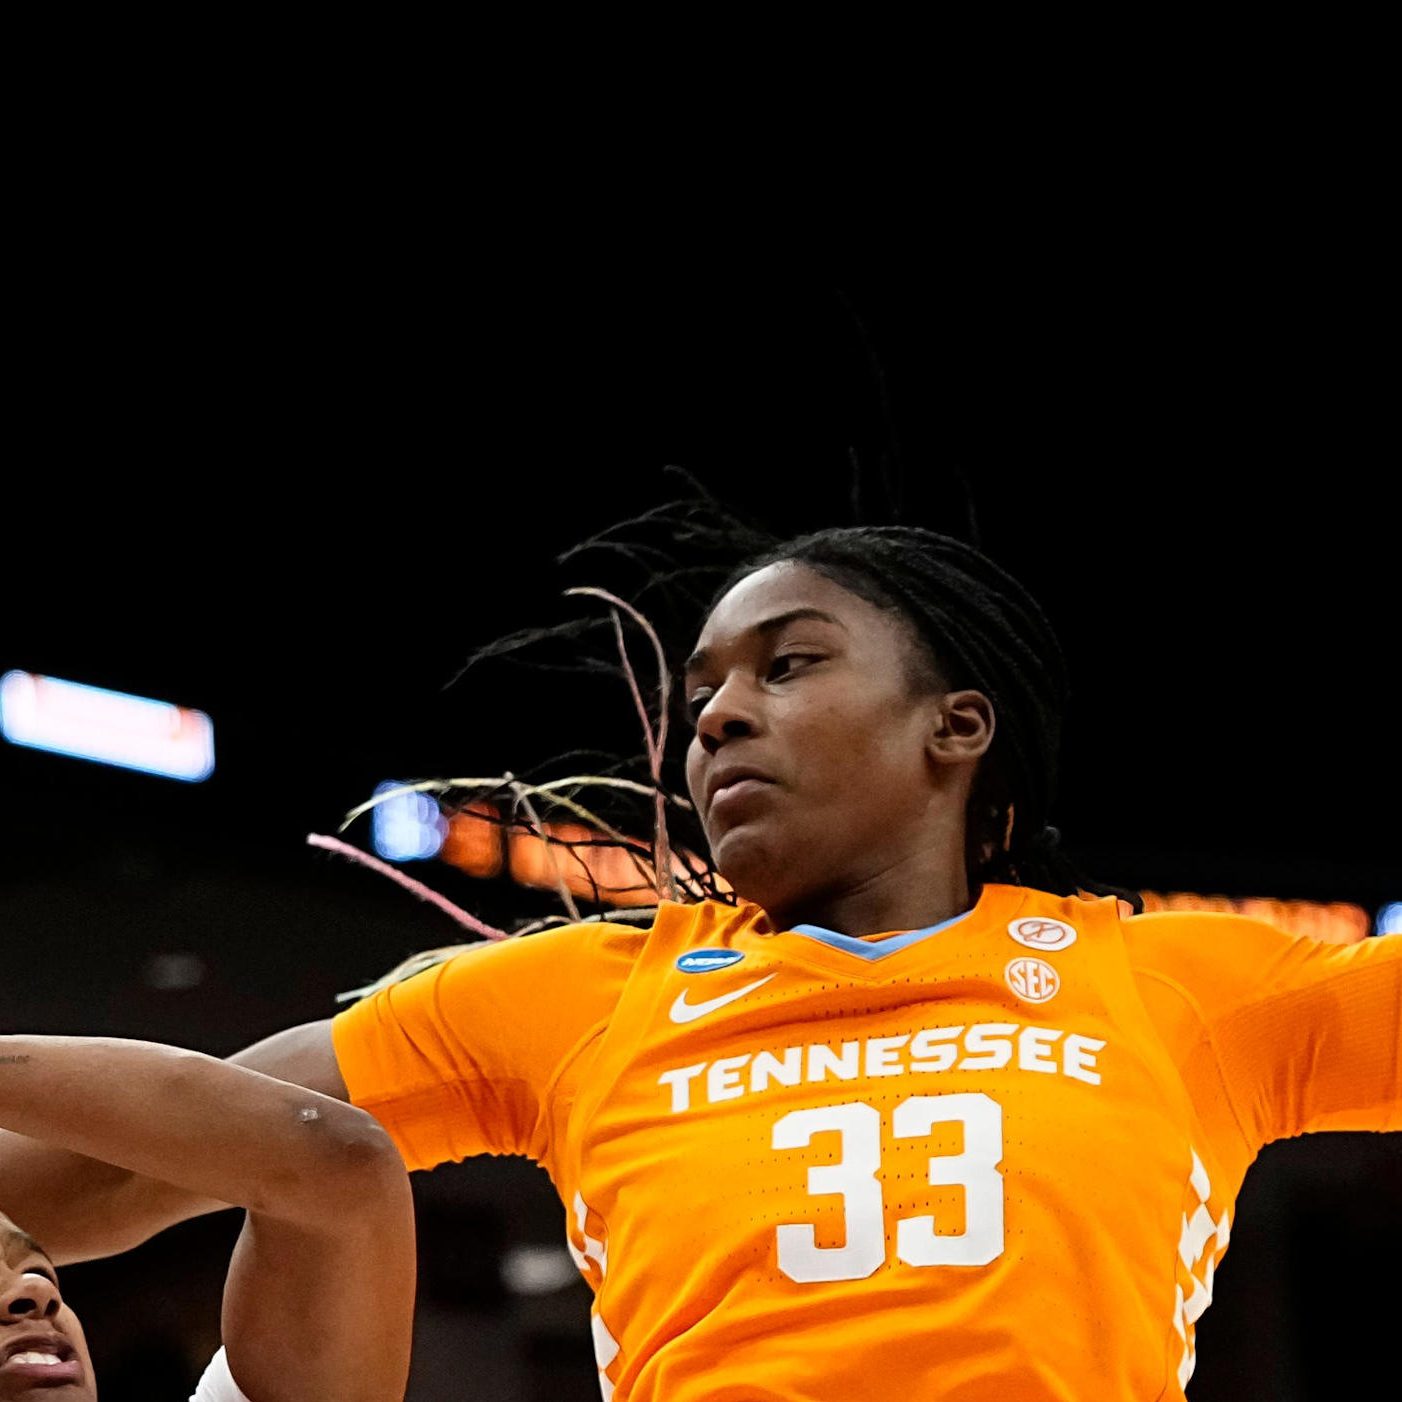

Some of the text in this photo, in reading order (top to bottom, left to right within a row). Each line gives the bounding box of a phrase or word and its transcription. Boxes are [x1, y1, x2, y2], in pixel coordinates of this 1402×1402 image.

[1009, 960, 1055, 1000] SEC
[658, 1023, 1107, 1114] TENNESSEE
[771, 1092, 1005, 1284] 33
